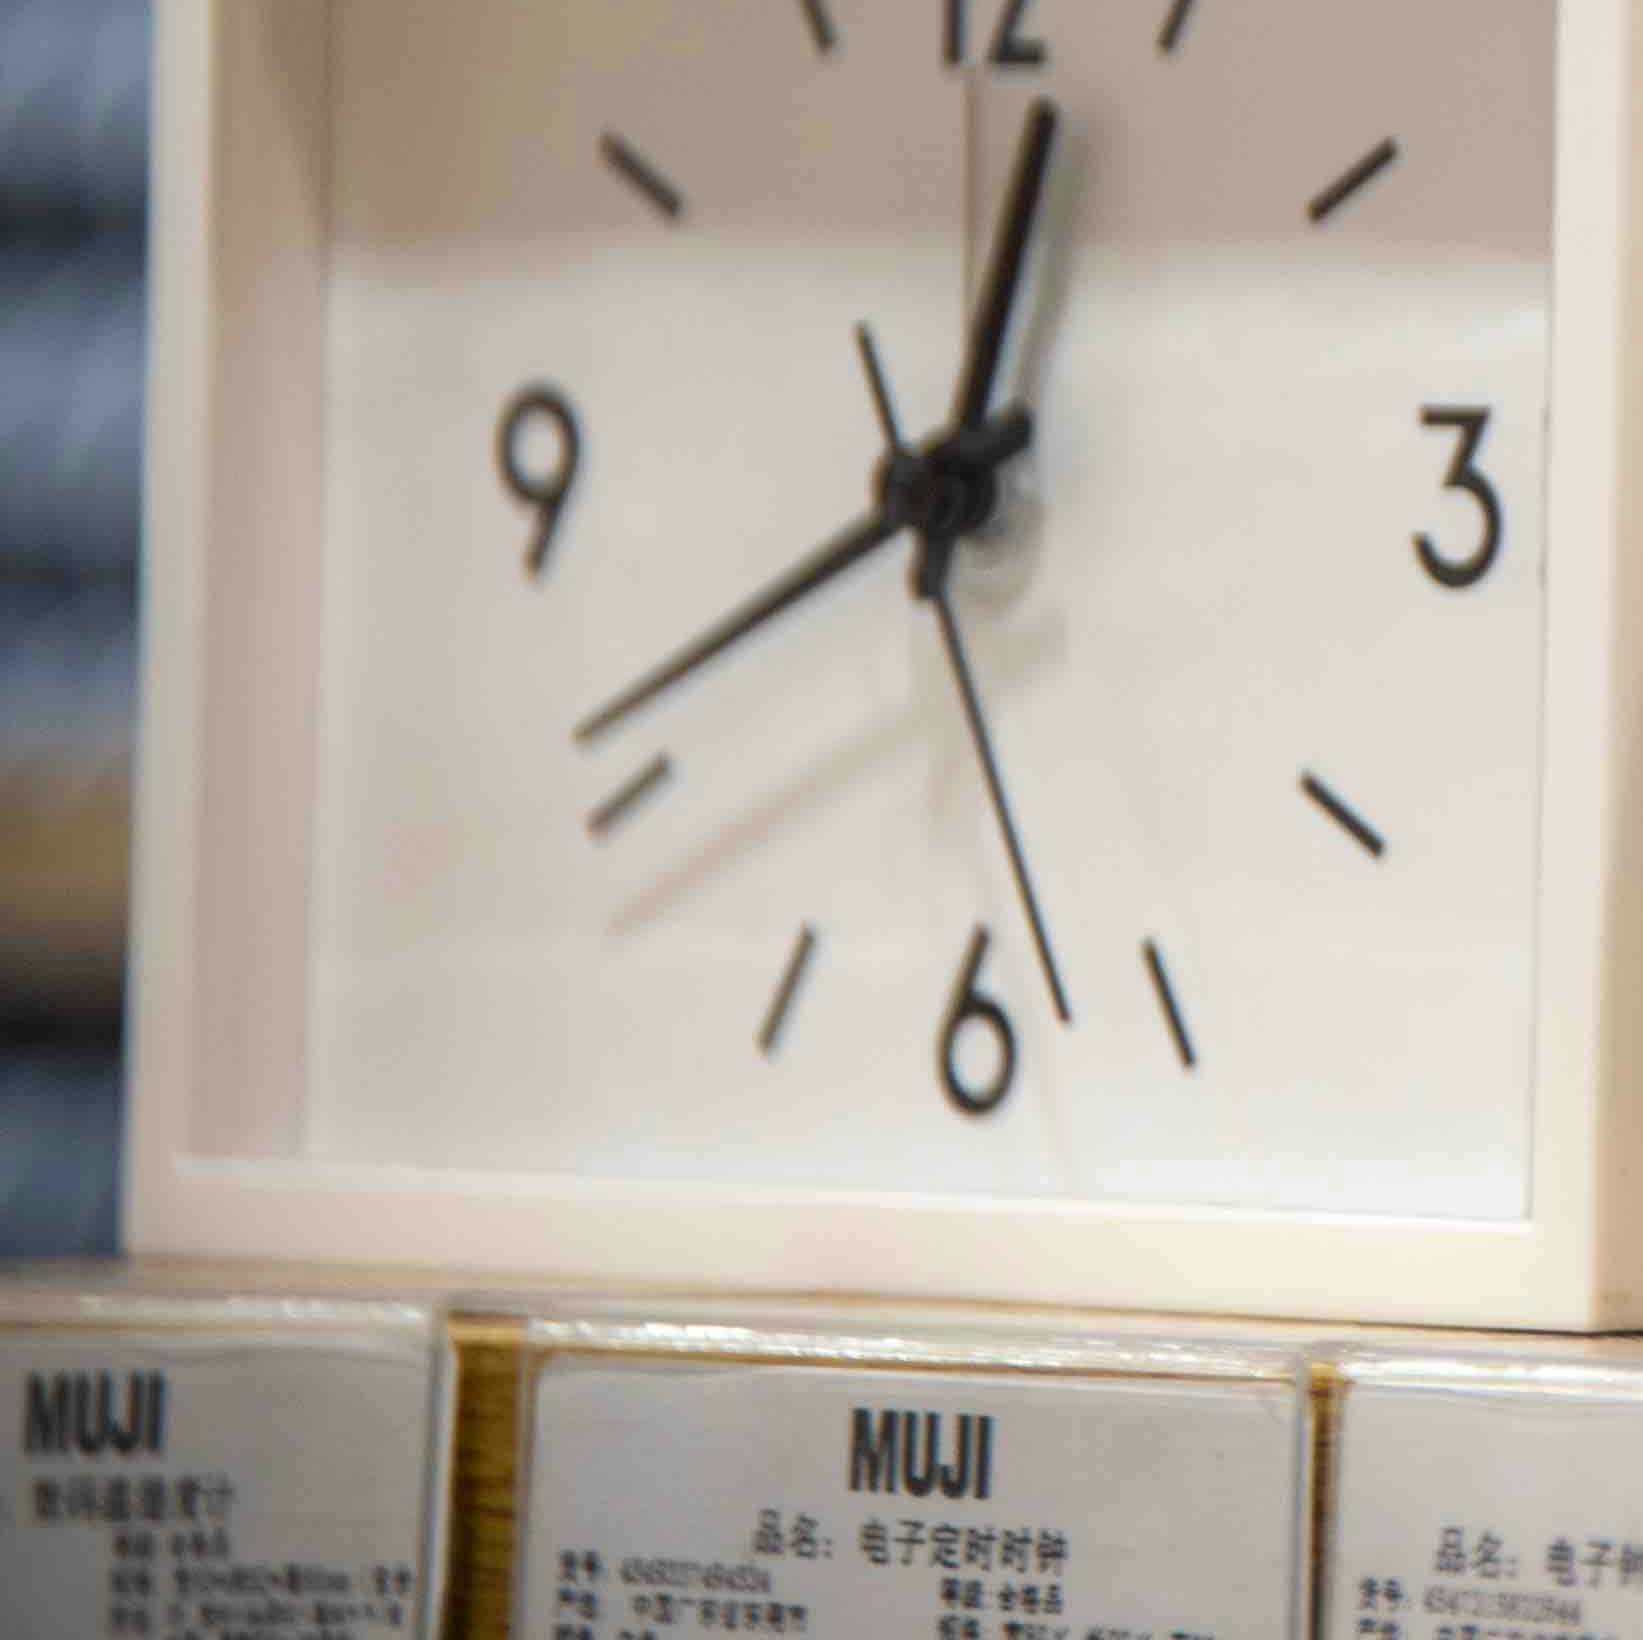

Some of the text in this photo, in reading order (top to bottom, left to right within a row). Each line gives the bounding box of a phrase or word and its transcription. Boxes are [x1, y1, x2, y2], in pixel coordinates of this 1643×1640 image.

[497, 382, 582, 583] 9
[1412, 405, 1503, 590] 3
[938, 926, 1018, 1117] 6
[24, 1371, 166, 1456] MUJI
[848, 1406, 994, 1500] MUJI
